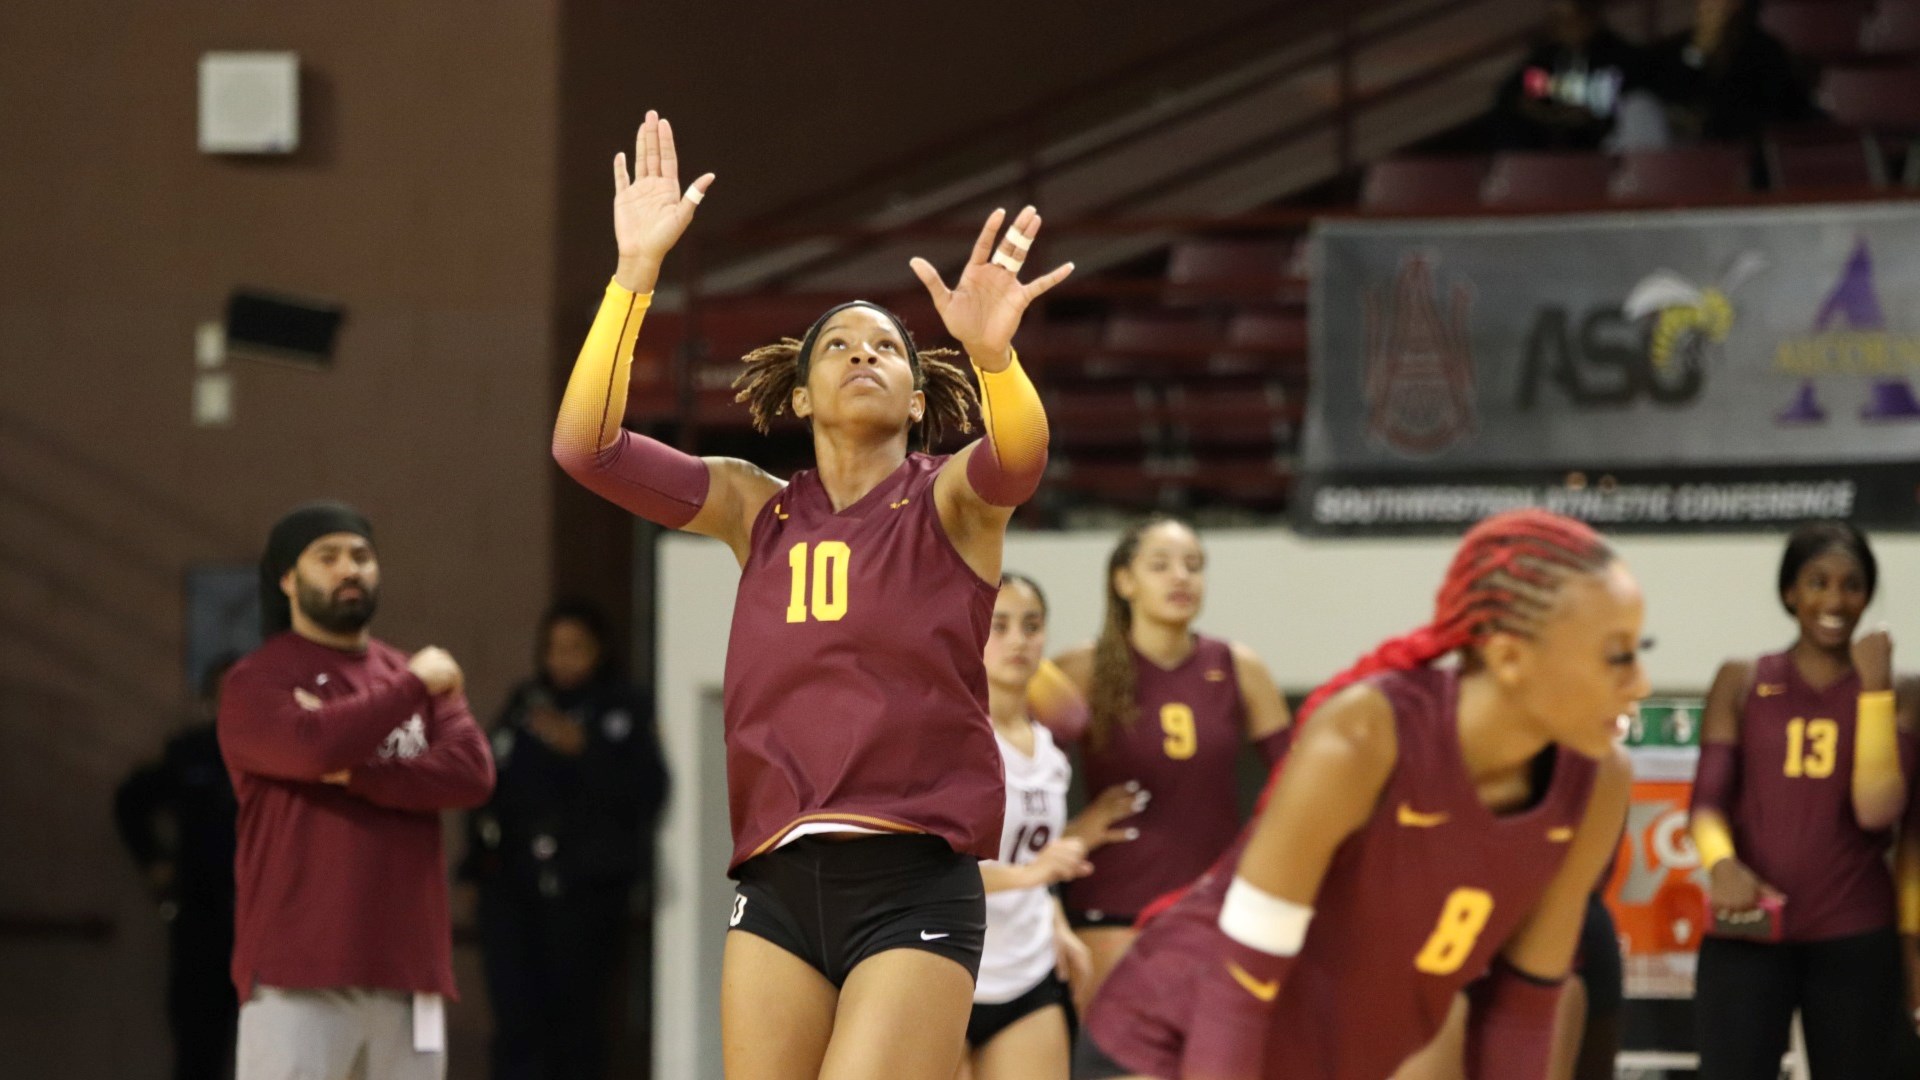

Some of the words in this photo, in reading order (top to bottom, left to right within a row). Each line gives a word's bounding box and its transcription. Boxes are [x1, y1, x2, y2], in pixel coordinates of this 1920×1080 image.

[786, 541, 851, 623] 10
[1160, 702, 1197, 760] 9
[1783, 717, 1839, 778] 13
[1653, 812, 1700, 868] G
[1414, 887, 1494, 975] 8
